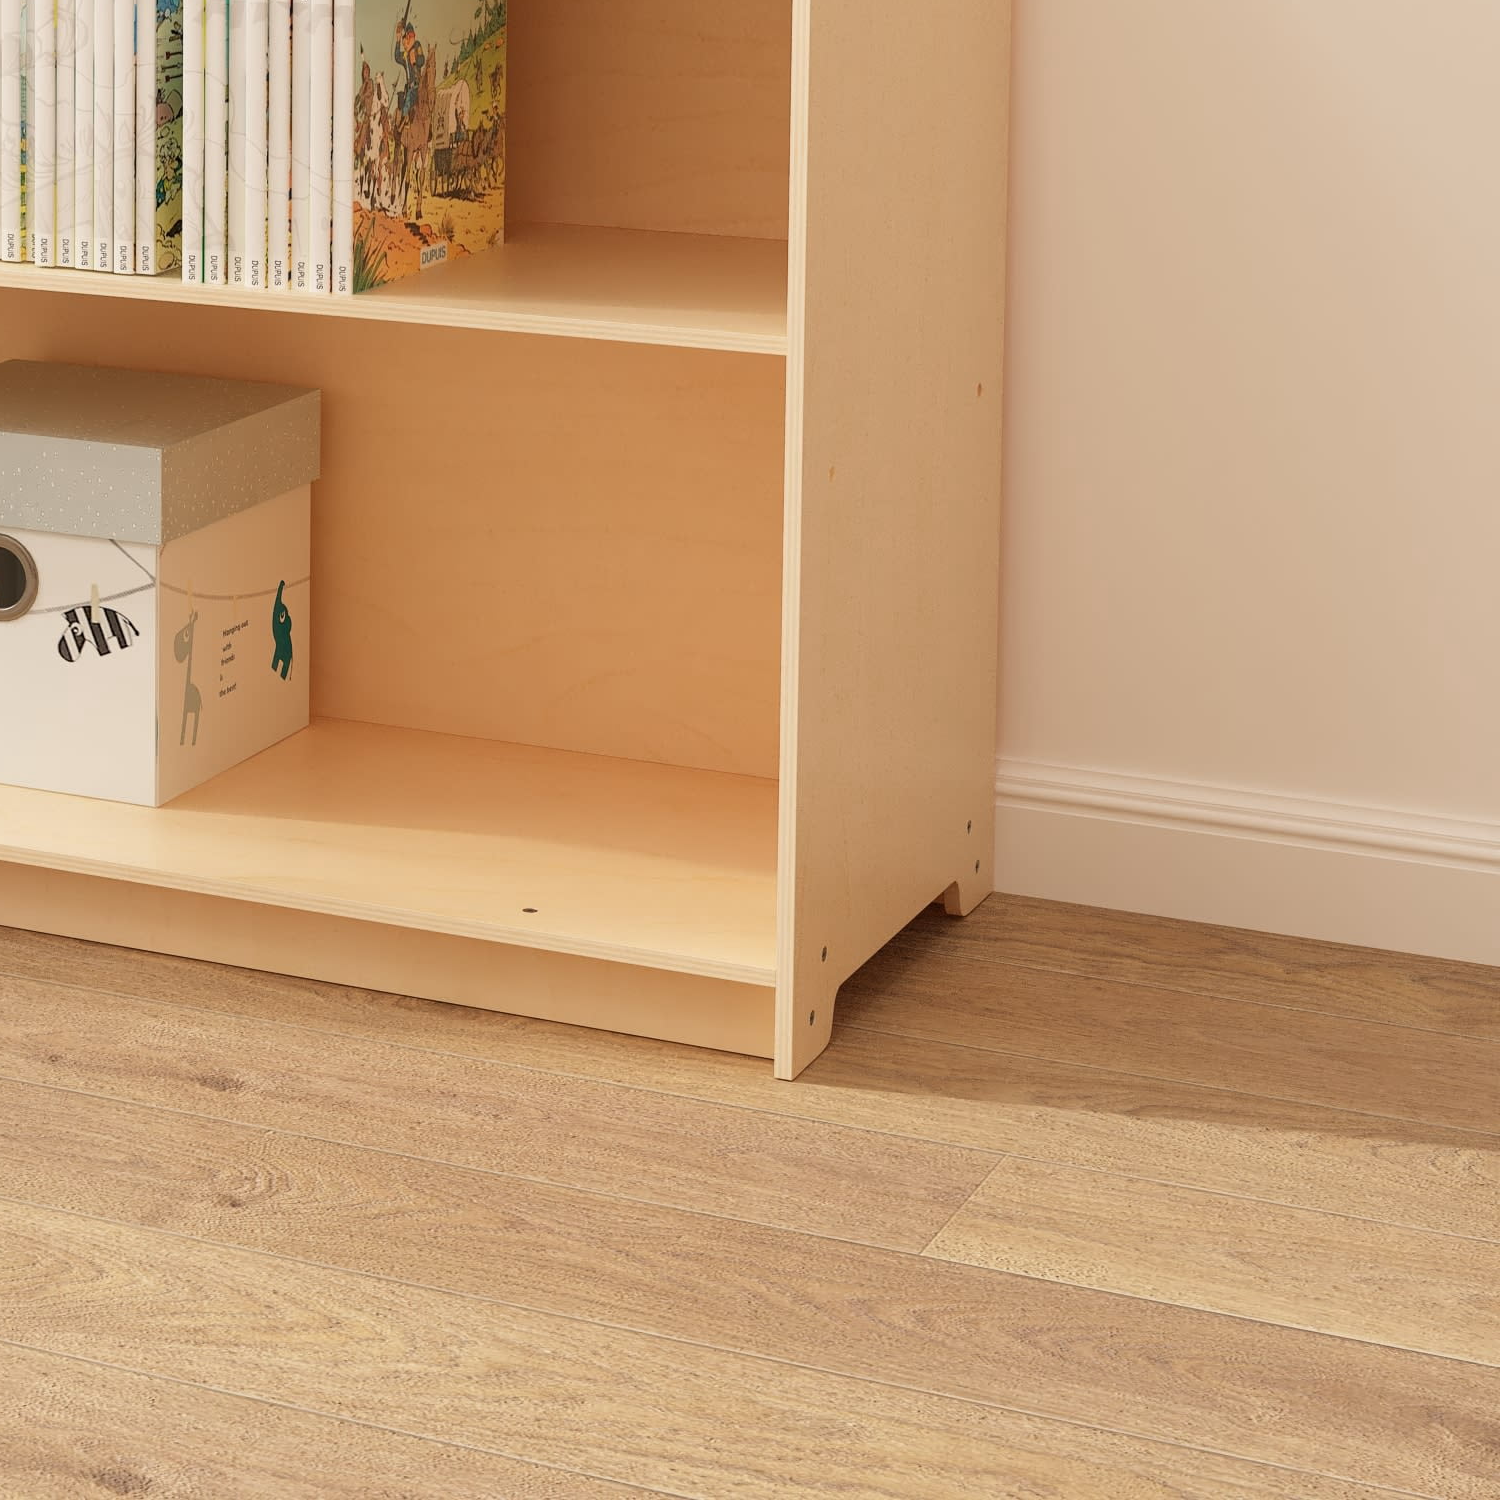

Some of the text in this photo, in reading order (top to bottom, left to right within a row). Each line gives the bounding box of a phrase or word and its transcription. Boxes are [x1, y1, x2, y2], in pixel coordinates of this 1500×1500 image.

[40, 238, 48, 263] DUPUIS
[421, 245, 446, 264] DUPUIS
[188, 254, 196, 280] DUPUIS
[338, 265, 347, 292] DUPUIS
[223, 619, 249, 637] Hanging out
